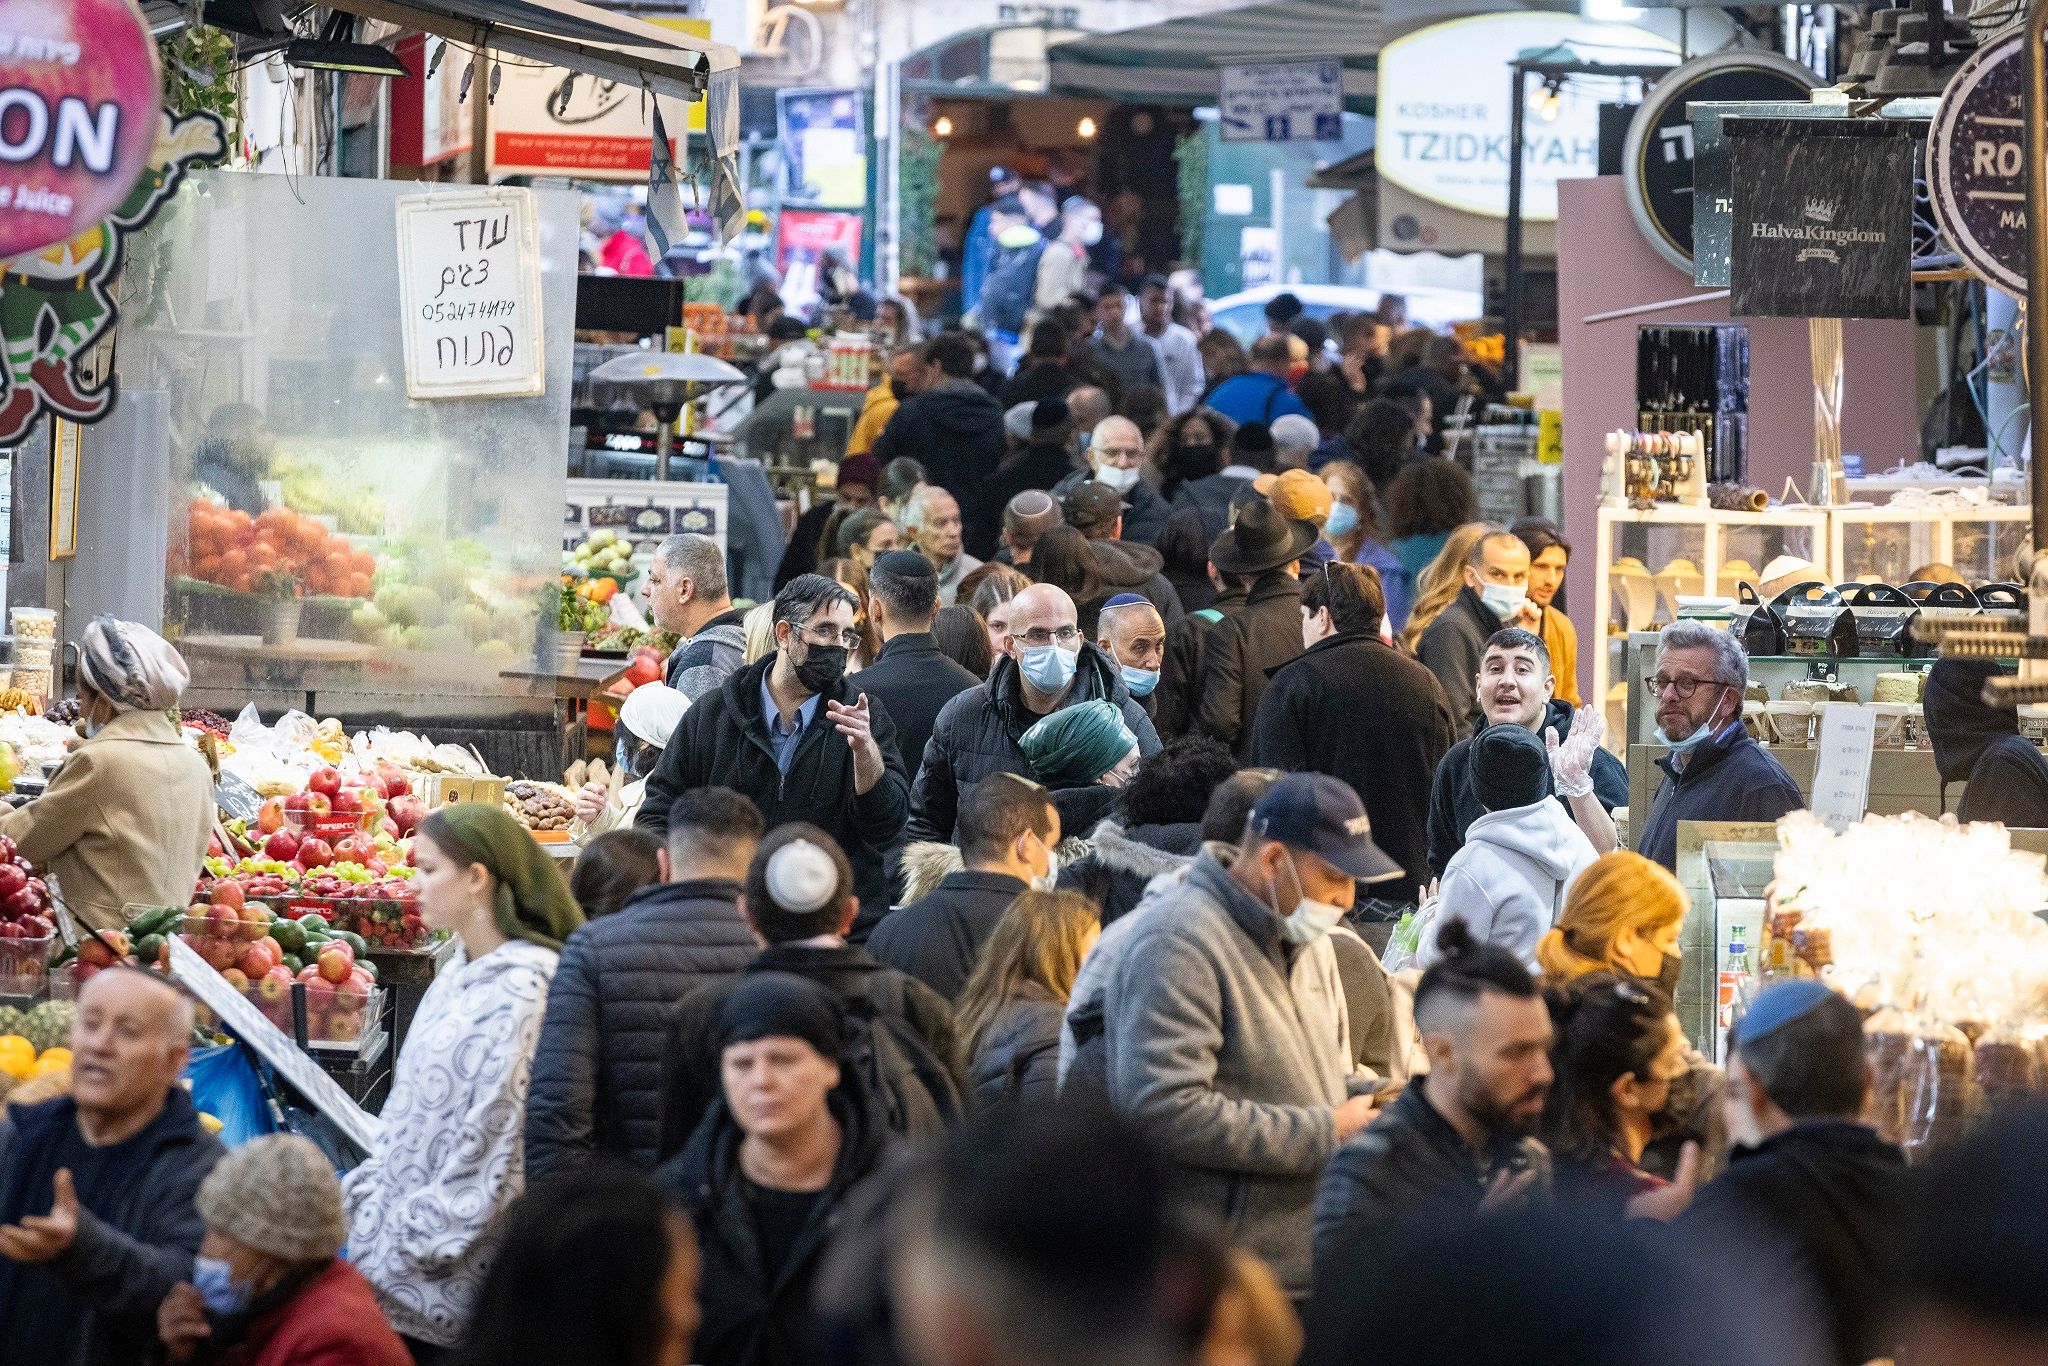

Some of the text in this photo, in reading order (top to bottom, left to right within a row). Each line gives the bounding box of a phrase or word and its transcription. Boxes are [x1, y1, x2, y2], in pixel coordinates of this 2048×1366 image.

[1397, 102, 1488, 119] KOSHER
[1396, 131, 1599, 165] TZIDKYAH
[14, 183, 73, 217] Juice
[1751, 222, 1886, 246] HalvaKingdom
[436, 325, 514, 369] פתוח
